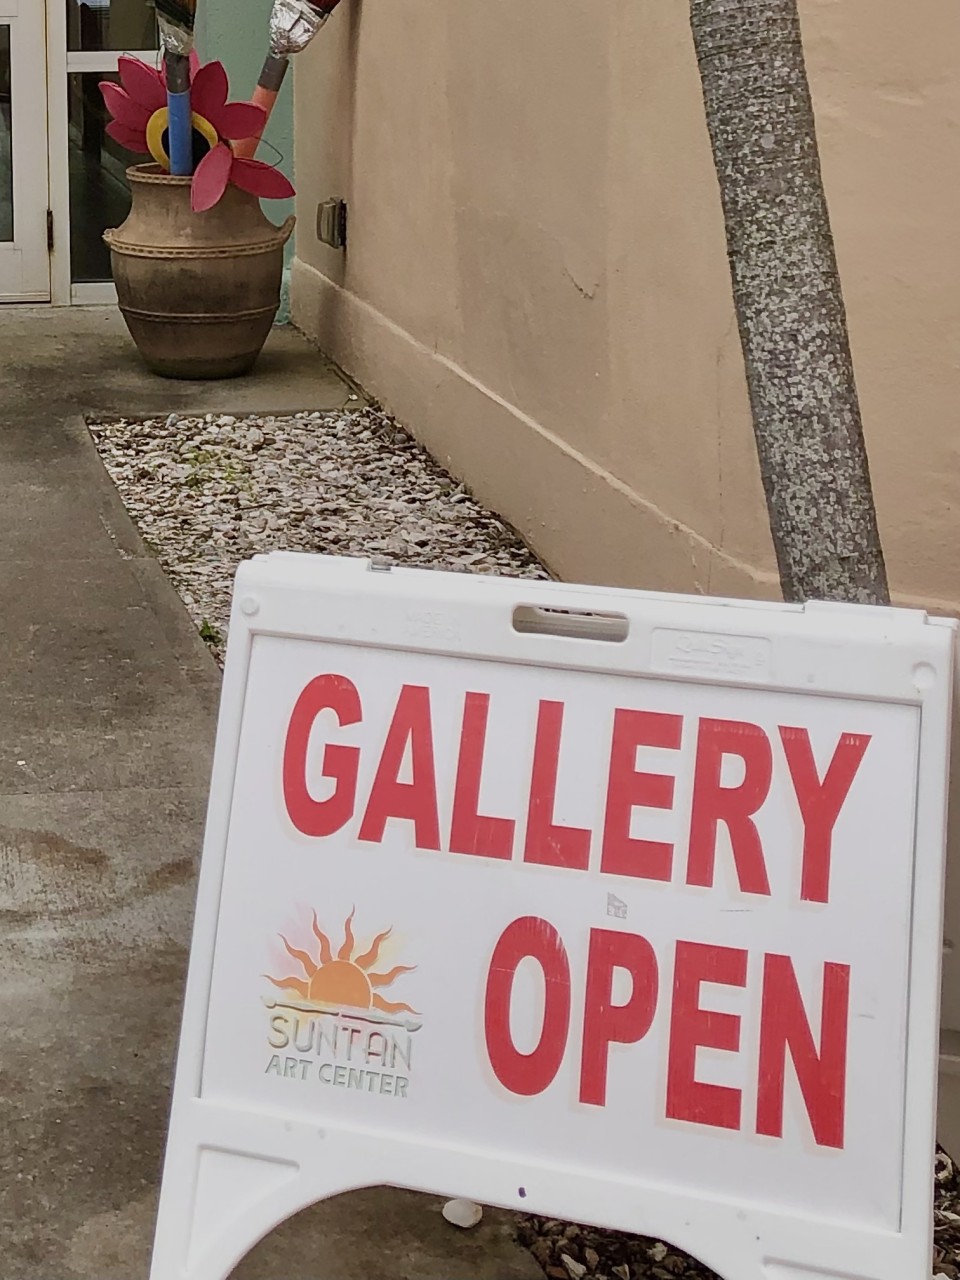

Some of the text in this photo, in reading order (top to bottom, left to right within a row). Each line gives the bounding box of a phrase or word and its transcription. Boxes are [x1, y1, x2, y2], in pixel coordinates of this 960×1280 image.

[282, 673, 873, 904] GALLERY
[265, 1054, 410, 1098] ART CENTER
[267, 1012, 412, 1071] SUNTAN
[484, 916, 851, 1150] OPEN
